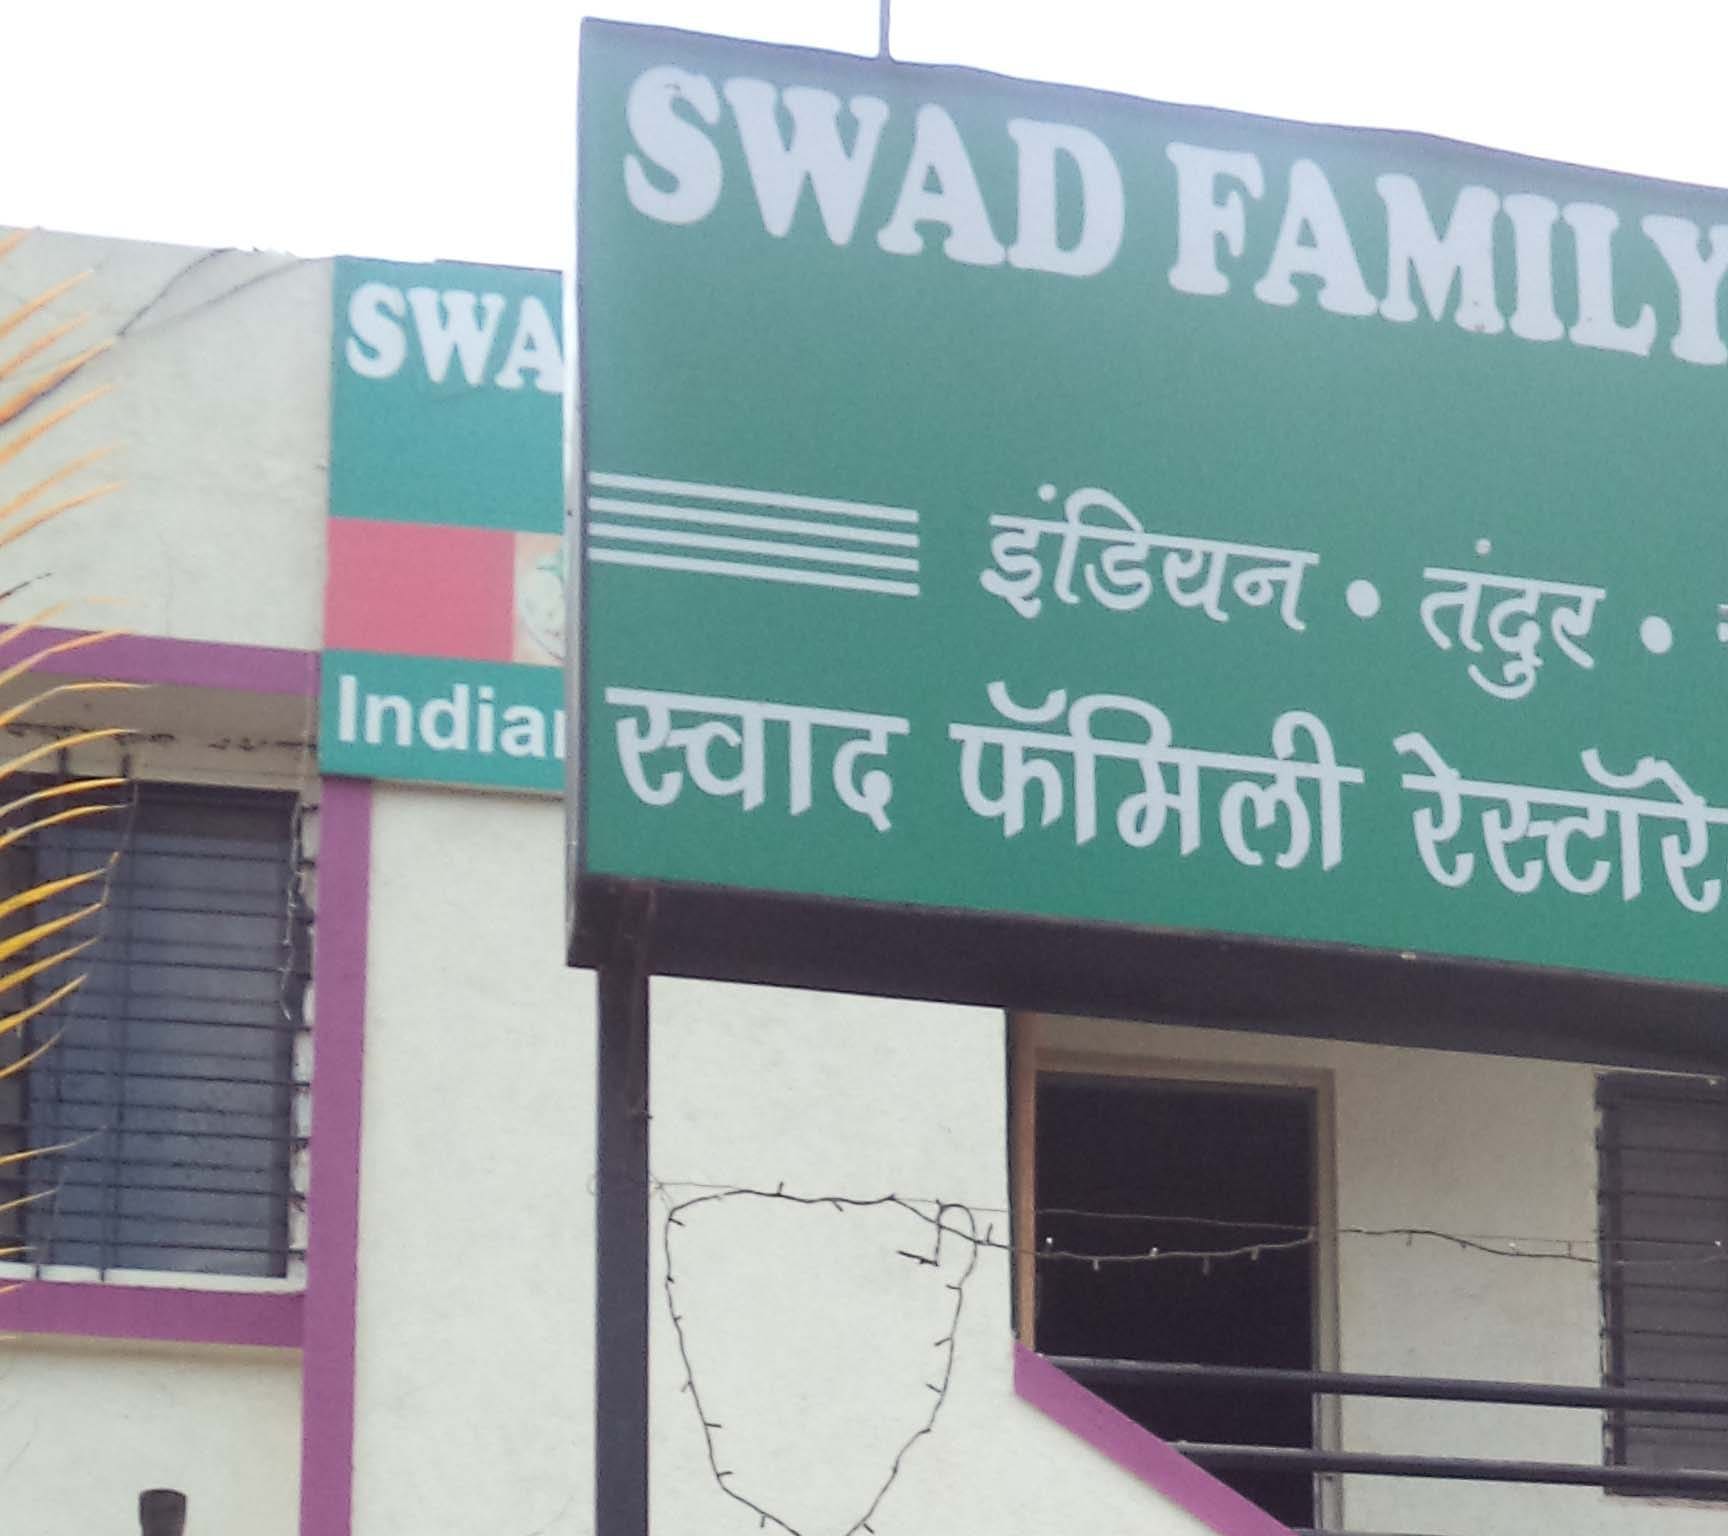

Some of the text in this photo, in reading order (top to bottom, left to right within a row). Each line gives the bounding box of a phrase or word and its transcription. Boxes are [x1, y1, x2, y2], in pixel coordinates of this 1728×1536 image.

[622, 64, 1126, 279] SWAD
[979, 483, 1321, 632] इंडियन
[1419, 538, 1607, 701] तंदुर
[337, 674, 567, 762] India
[604, 686, 910, 832] स्वाद
[948, 680, 1365, 871] फॅमिली
